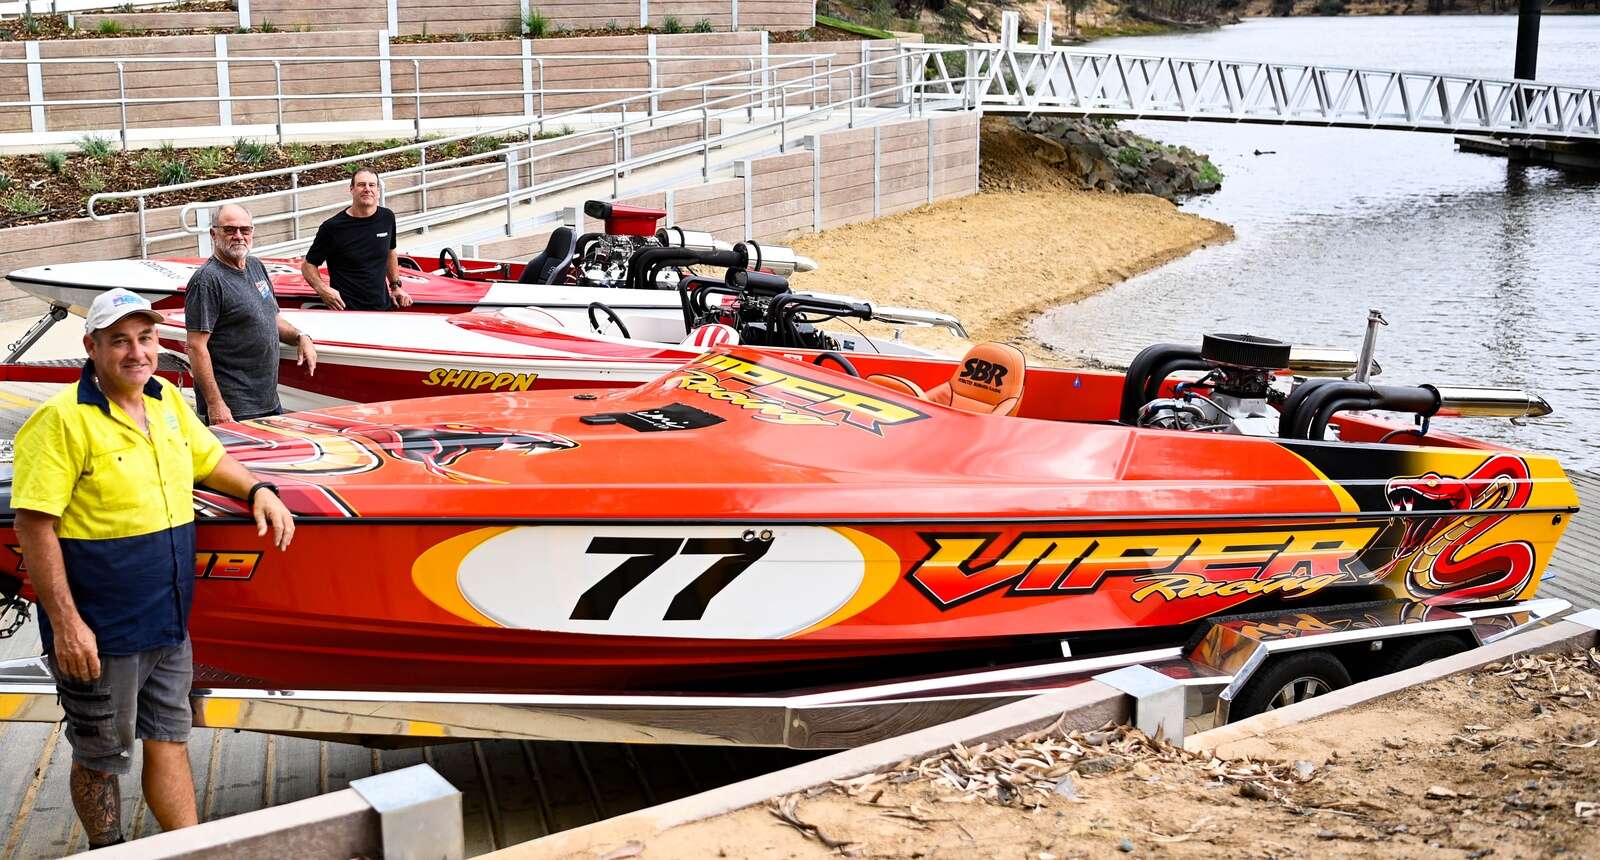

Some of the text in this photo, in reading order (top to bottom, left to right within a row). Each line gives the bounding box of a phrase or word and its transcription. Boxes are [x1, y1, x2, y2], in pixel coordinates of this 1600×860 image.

[421, 367, 538, 392] SHIPPN
[959, 357, 1008, 387] SBR
[671, 368, 839, 426] Racing
[568, 536, 775, 621] 77
[905, 521, 1390, 611] VIPER
[1130, 572, 1349, 602] Racing
